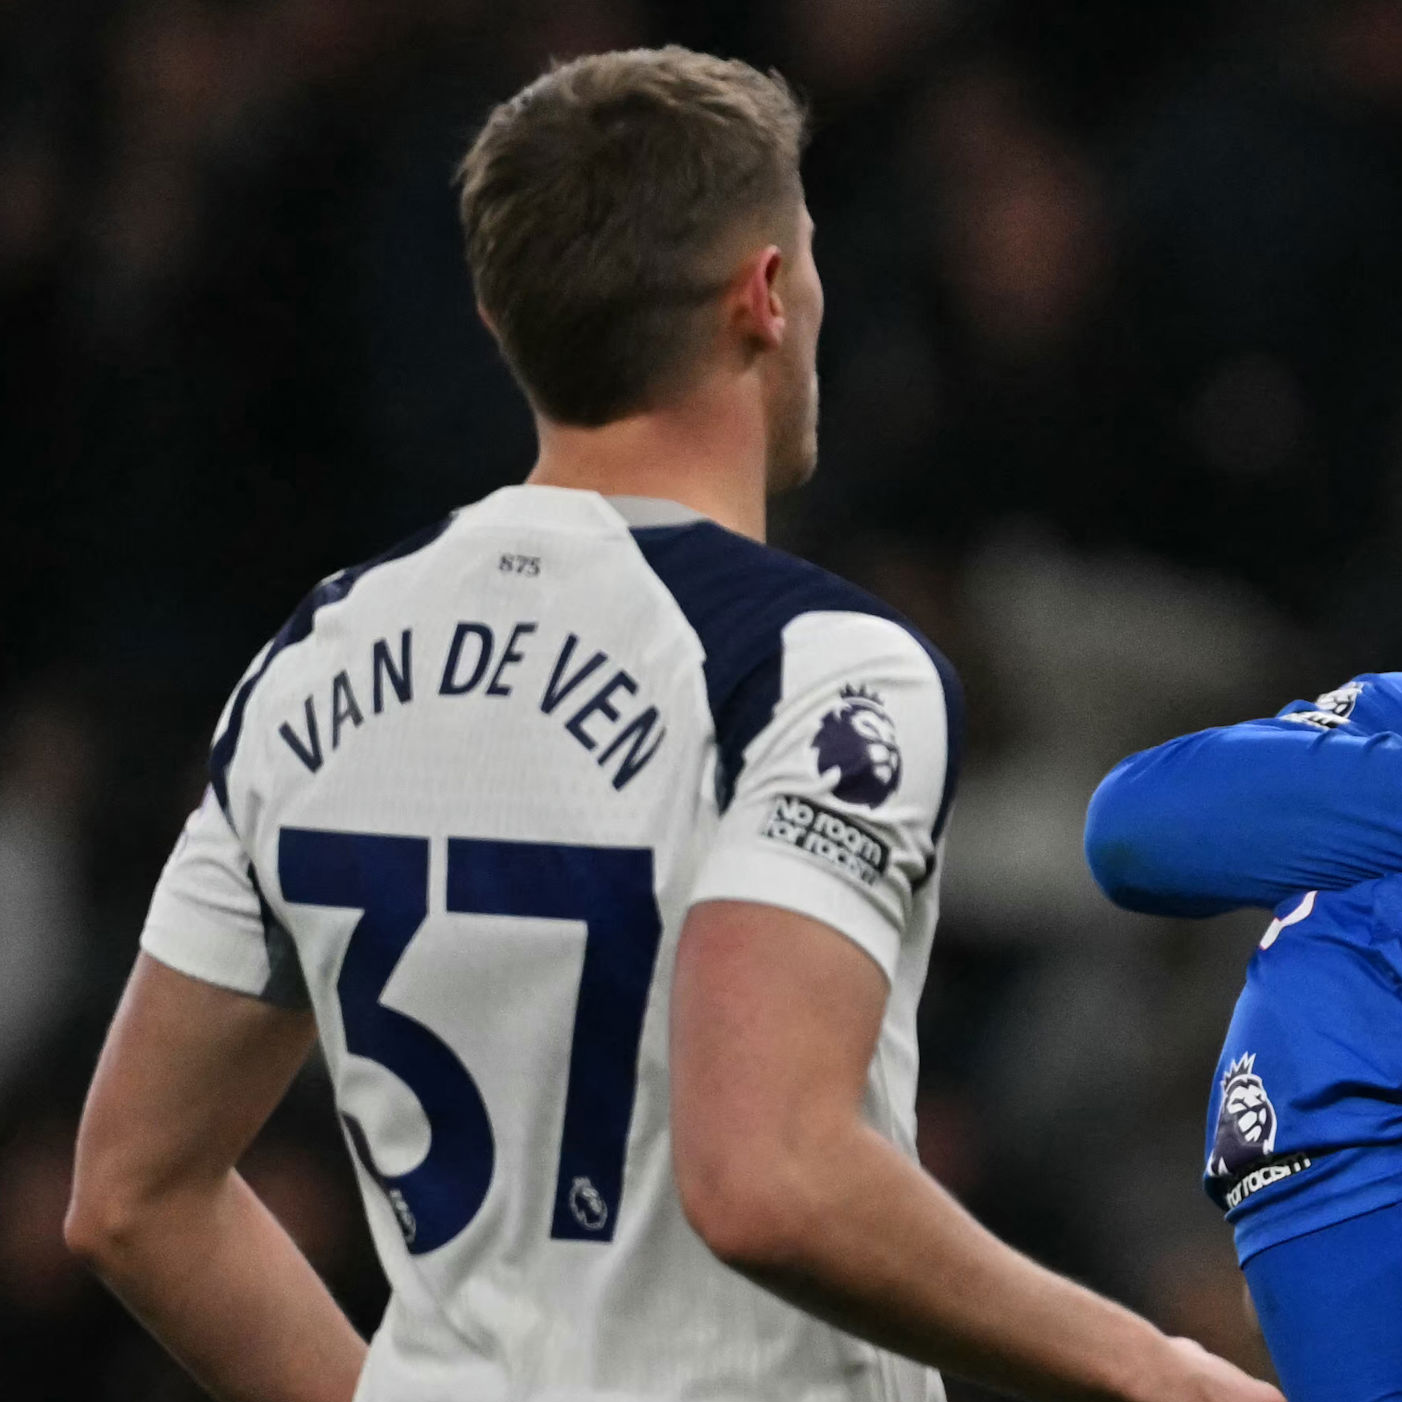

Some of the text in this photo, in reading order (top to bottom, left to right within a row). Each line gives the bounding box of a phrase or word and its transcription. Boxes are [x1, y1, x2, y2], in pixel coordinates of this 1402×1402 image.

[279, 620, 668, 792] VAN DE VEN
[775, 796, 882, 867] No room
[278, 827, 664, 1256] 37
